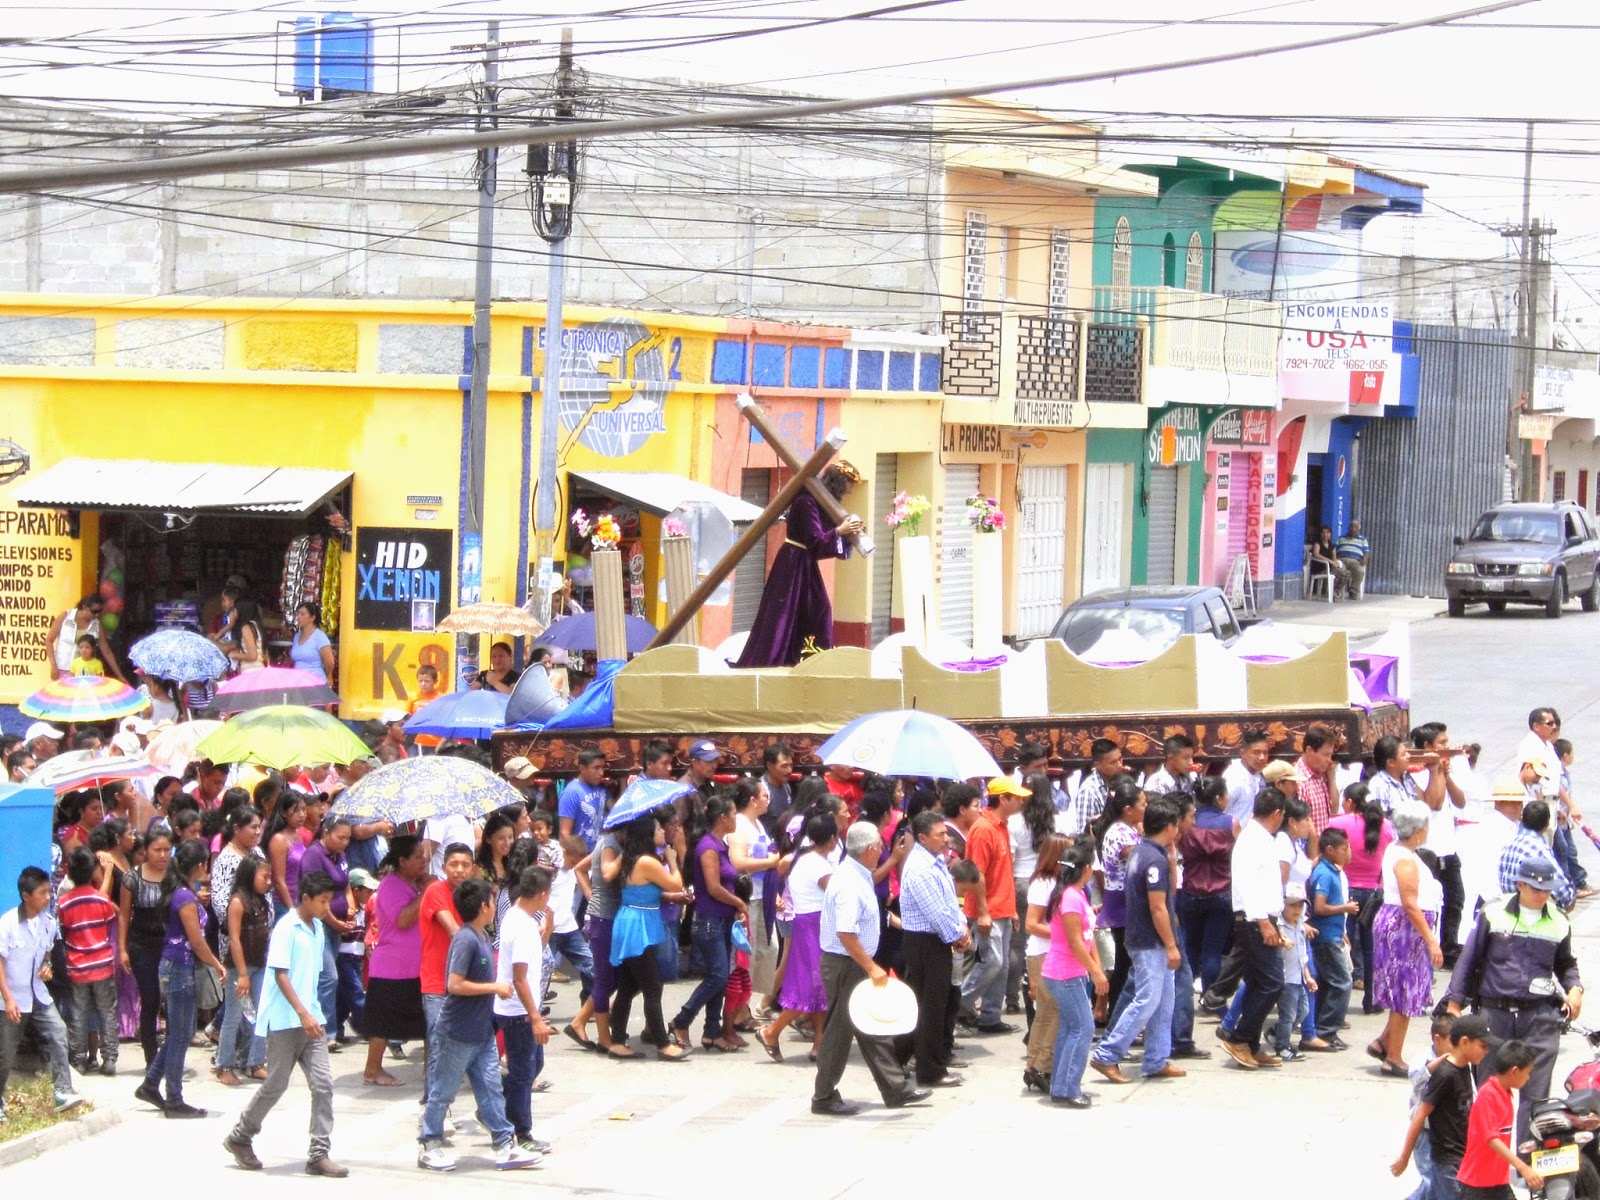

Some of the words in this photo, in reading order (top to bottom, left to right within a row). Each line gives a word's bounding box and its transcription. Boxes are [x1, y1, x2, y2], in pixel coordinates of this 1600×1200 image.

[1286, 305, 1389, 318] ENCOMIENDAS
[1334, 318, 1342, 330] A
[1306, 329, 1368, 349] USA
[538, 328, 623, 355] ECTRONICA
[669, 336, 682, 380] 2
[1326, 348, 1352, 359] TELS:
[1285, 358, 1336, 370] 7924-7022
[599, 411, 667, 433] UNIVERSAL
[1013, 401, 1073, 425] MULTI-REPUESTOS
[942, 424, 955, 452] LA
[959, 424, 1002, 453] PROMESA
[1149, 430, 1202, 463] SAOMON
[375, 541, 429, 569] HID
[0, 563, 34, 577] UIPOS
[37, 564, 54, 579] DE
[358, 563, 441, 604] XENON
[10, 646, 48, 662] VIDEO
[0, 663, 33, 677] IGITAL
[1148, 866, 1160, 884] 3
